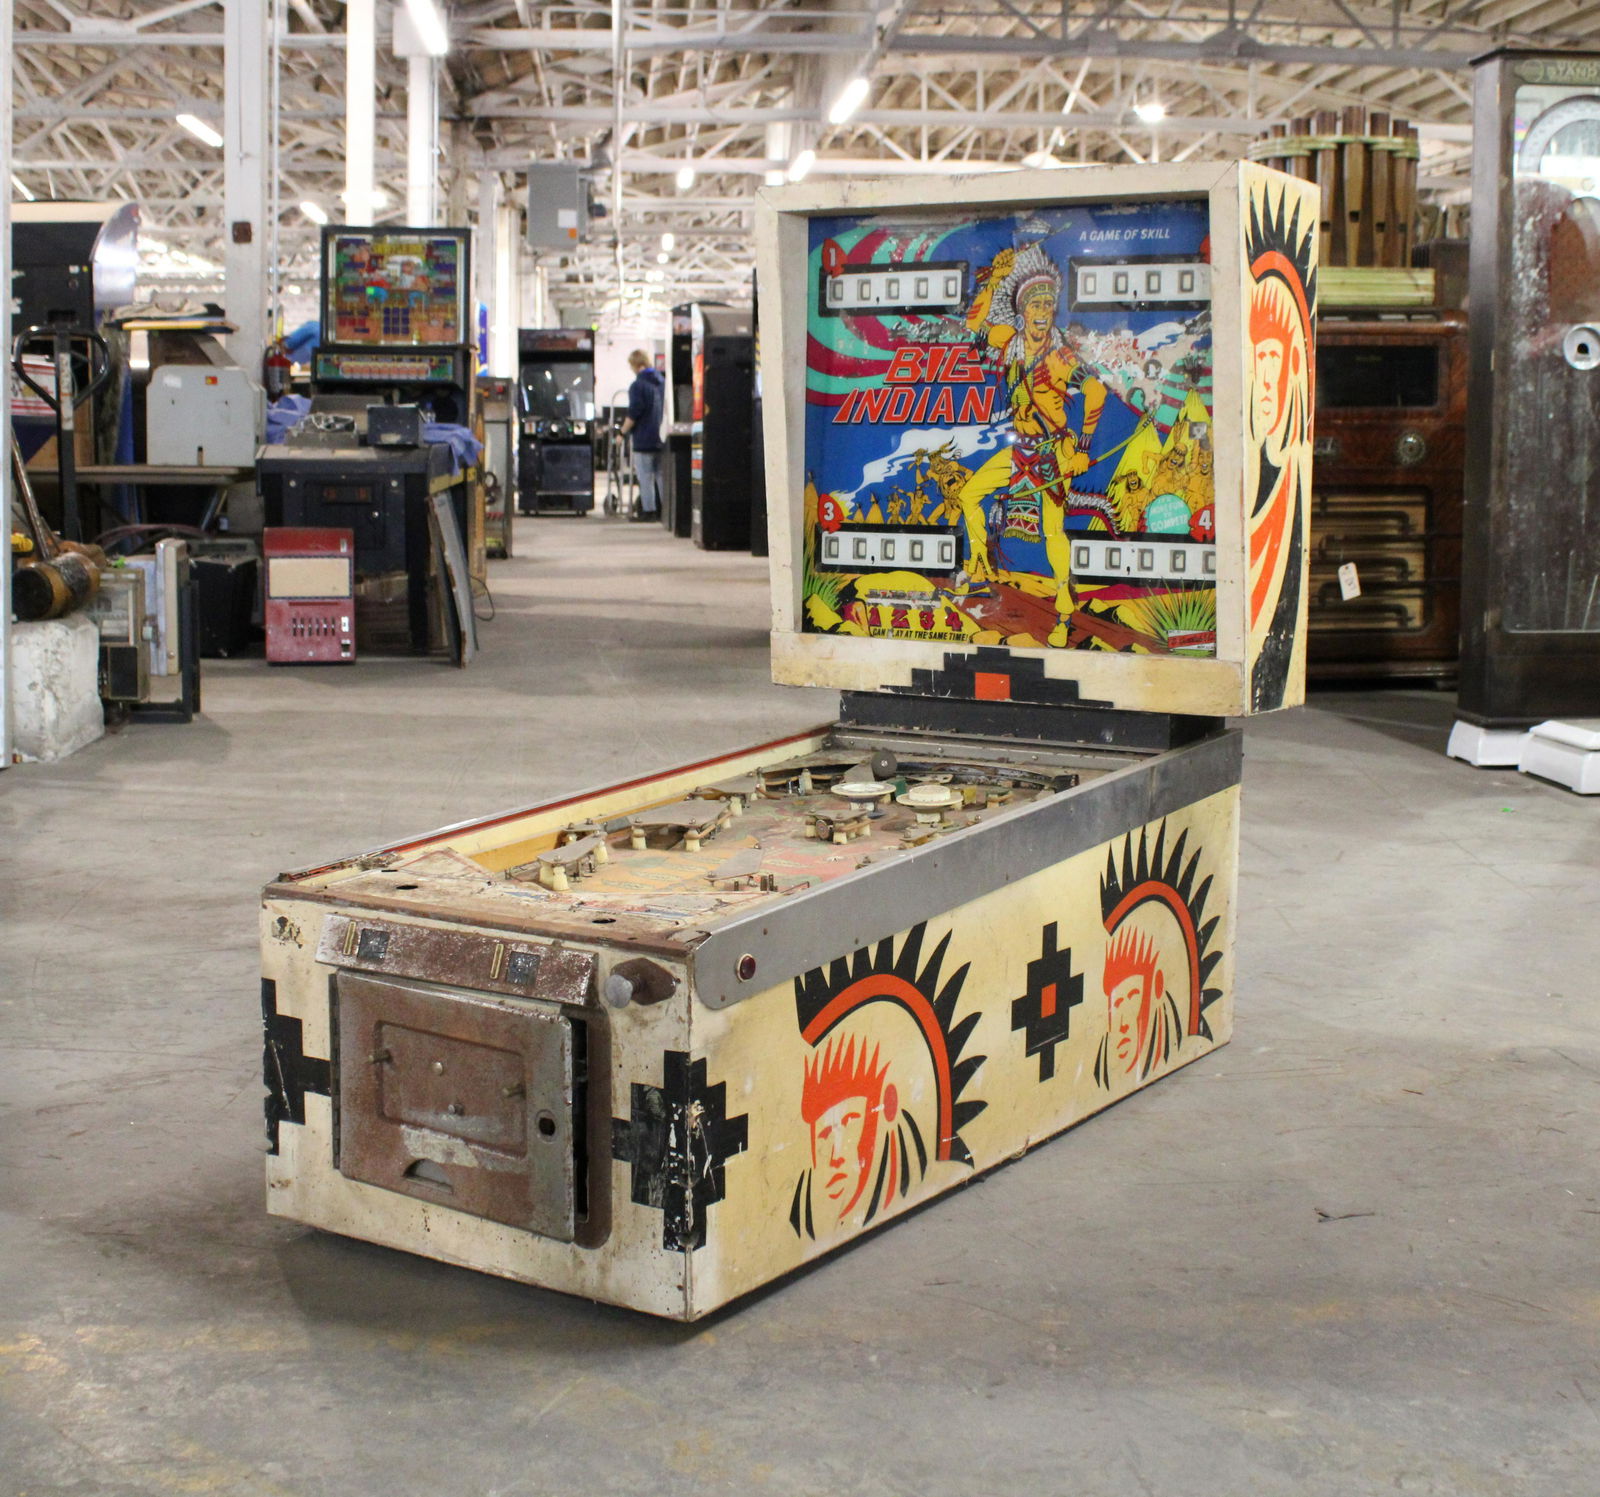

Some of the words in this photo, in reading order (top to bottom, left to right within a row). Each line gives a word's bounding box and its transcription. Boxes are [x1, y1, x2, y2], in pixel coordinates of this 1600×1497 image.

[1080, 231, 1087, 240] A
[1090, 230, 1121, 241] GAME
[1124, 229, 1139, 240] OF
[1141, 228, 1170, 239] SKILL
[829, 247, 836, 267] 1
[883, 346, 986, 384] BIG
[832, 386, 996, 424] INDIAN
[824, 502, 834, 521] 3
[1199, 509, 1213, 530] 4
[869, 603, 882, 627] 1
[891, 604, 911, 629] 2
[919, 605, 935, 630] 3
[944, 606, 963, 632] 4
[872, 628, 886, 637] CAN
[905, 629, 913, 638] AT
[914, 630, 928, 639] THE
[929, 631, 947, 641] SAME
[949, 632, 969, 642] TIME!
